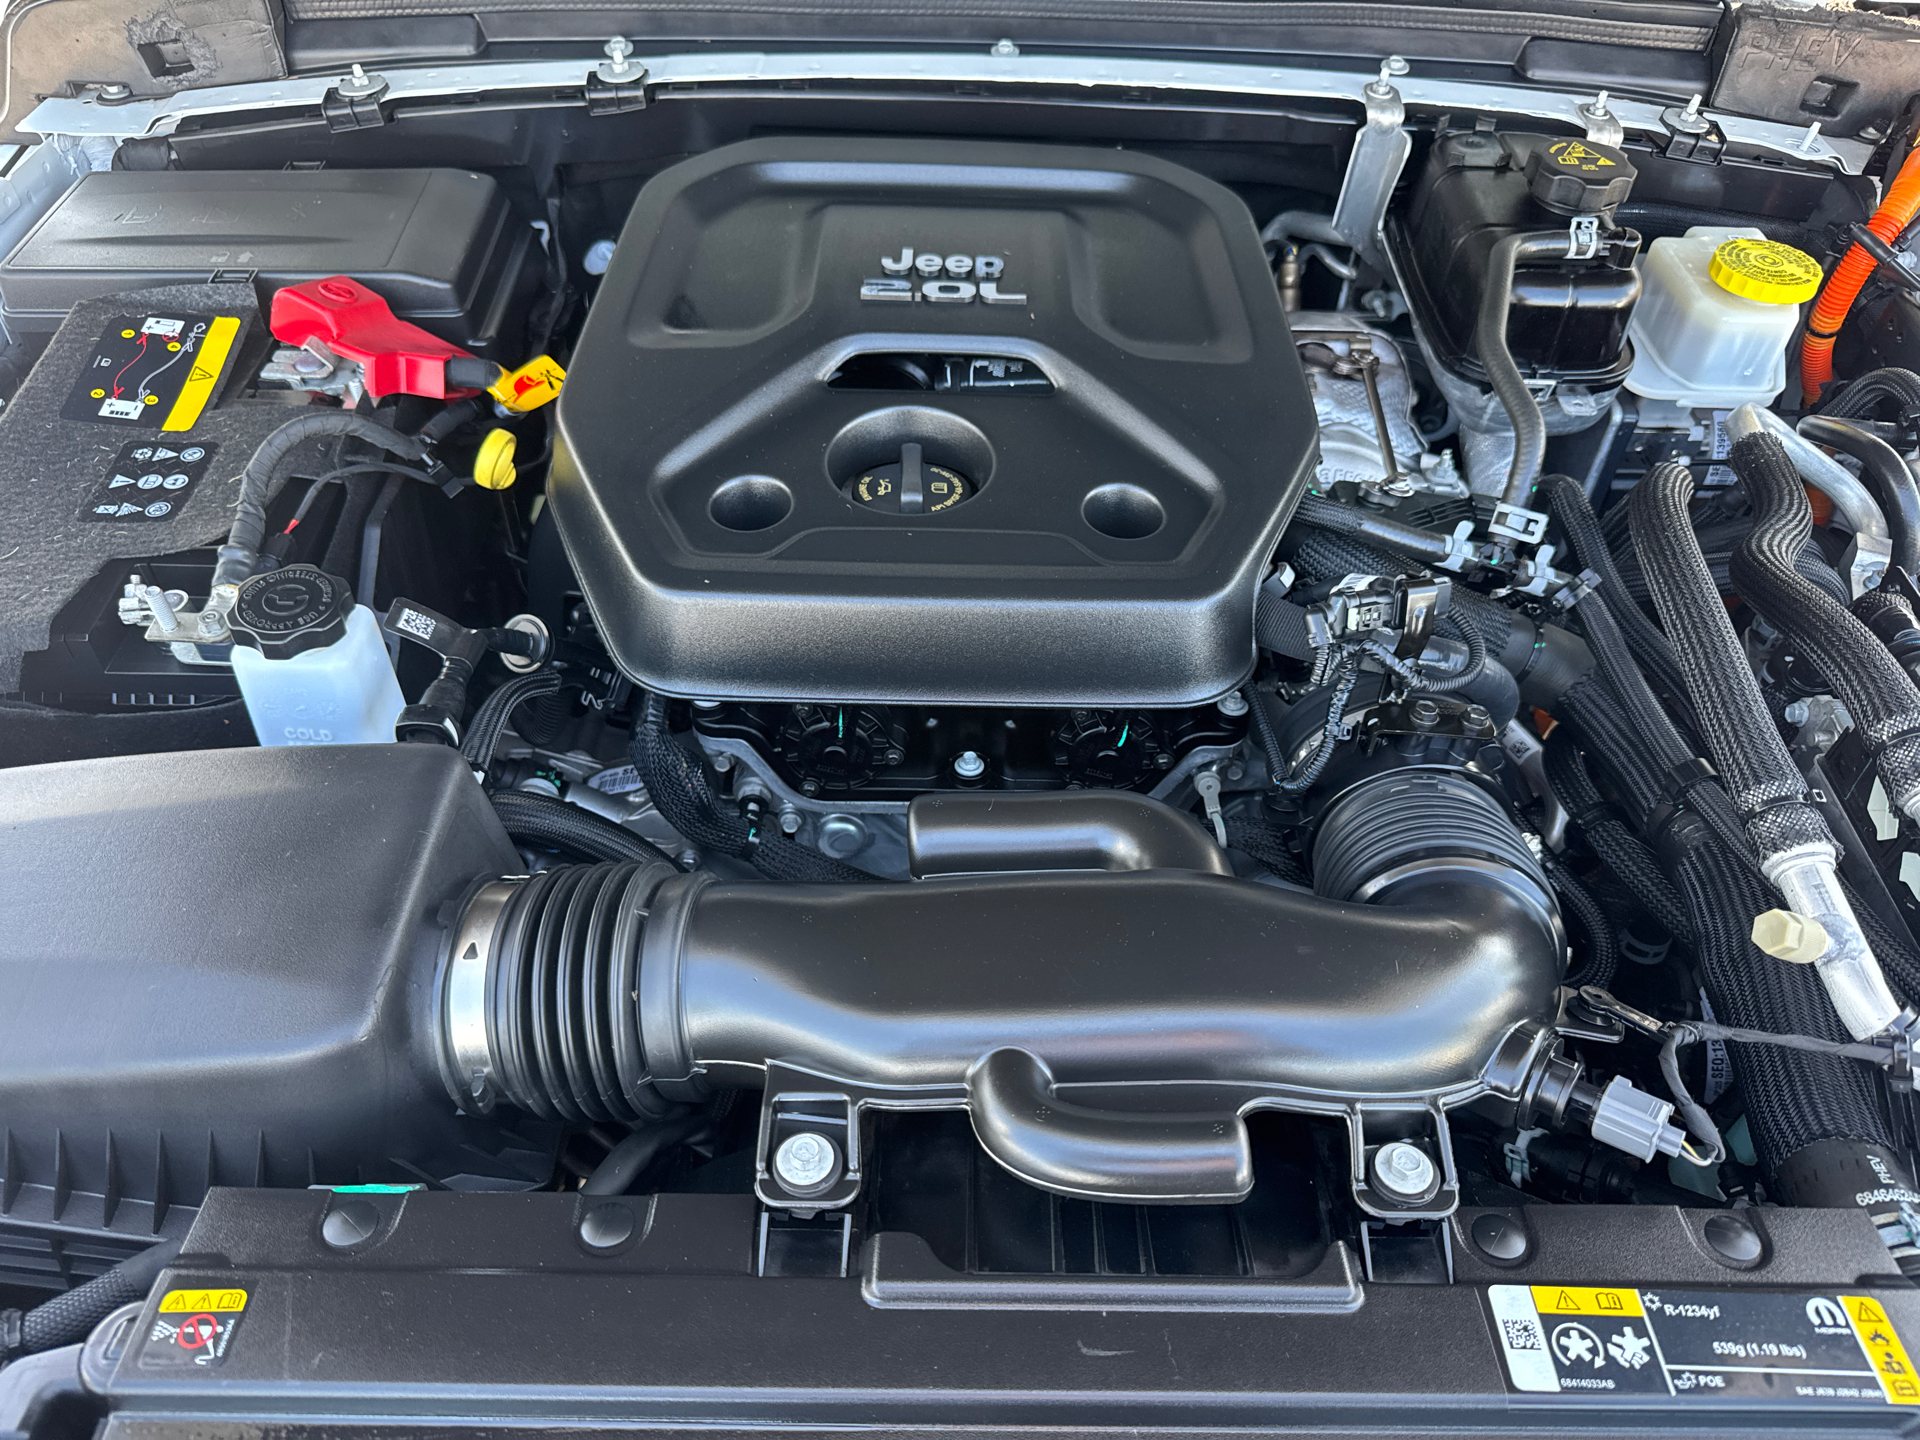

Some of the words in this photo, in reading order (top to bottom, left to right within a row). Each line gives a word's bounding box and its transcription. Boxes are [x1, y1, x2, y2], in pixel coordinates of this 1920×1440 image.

[1738, 31, 1865, 71] PHEV
[881, 246, 1005, 280] Jeep
[860, 278, 1028, 306] 2.0L
[858, 483, 873, 501] ENGINE
[930, 502, 946, 512] API
[266, 570, 319, 583] STEERING
[243, 580, 266, 600] FLUID
[316, 577, 333, 603] POWER
[243, 610, 294, 630] APPROVED
[298, 610, 319, 625] USE
[284, 727, 333, 742] COLD
[1866, 1155, 1895, 1184] PHEV
[1664, 1304, 1720, 1320] R-1234yf
[1712, 1341, 1746, 1358] 539g
[1746, 1342, 1778, 1358] (1.19
[1779, 1343, 1807, 1360] lbs)
[1698, 1375, 1726, 1388] POE
